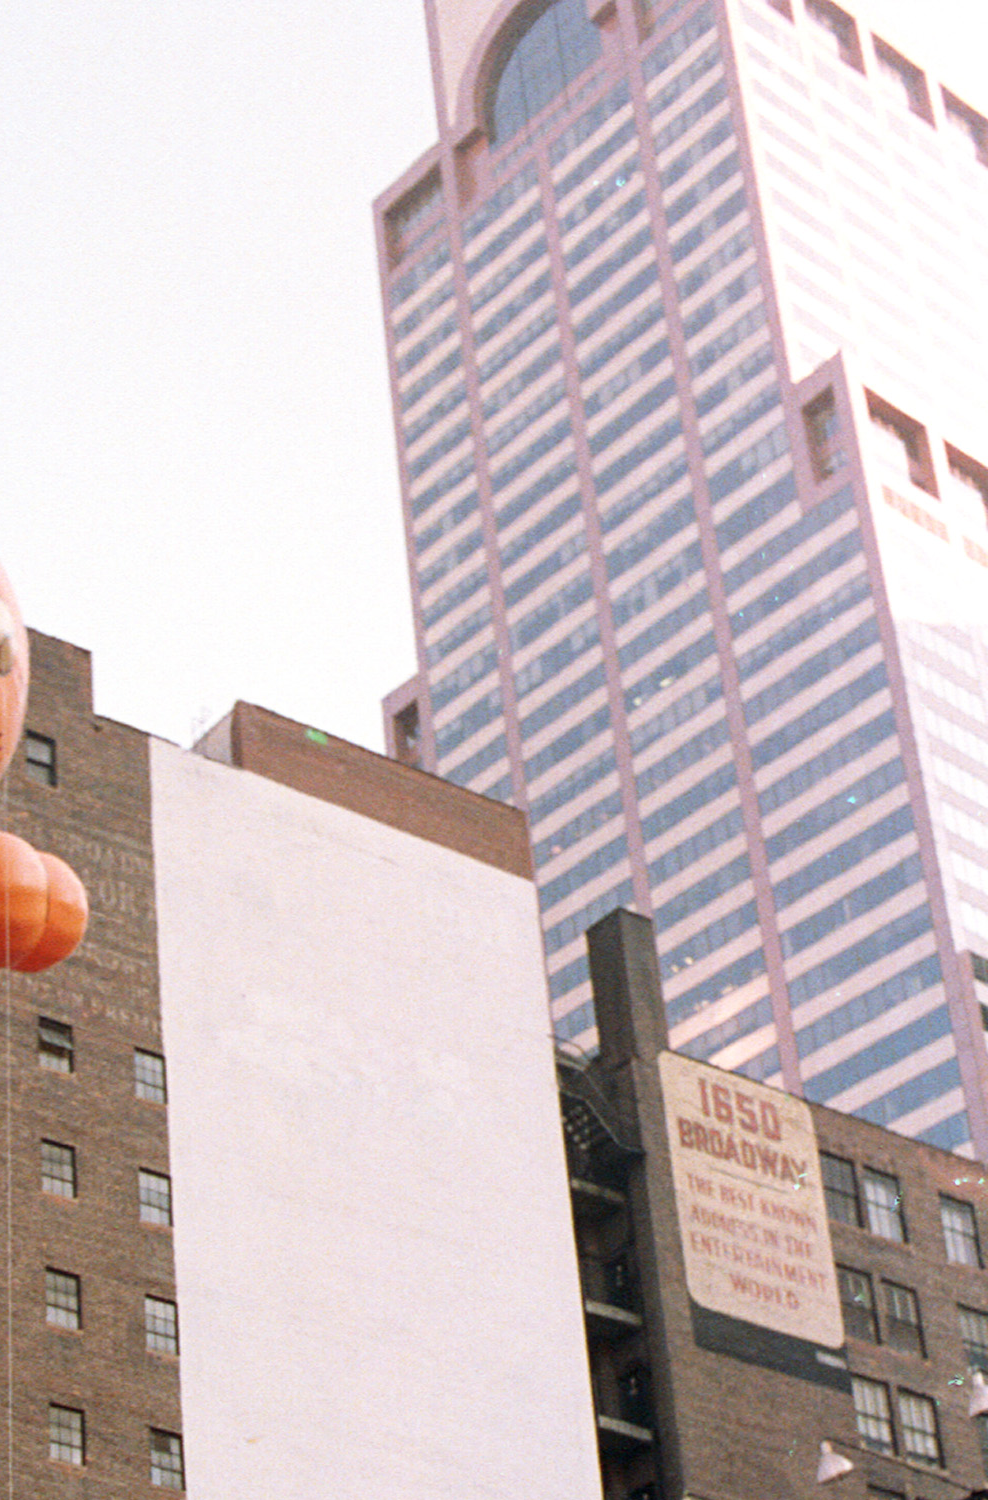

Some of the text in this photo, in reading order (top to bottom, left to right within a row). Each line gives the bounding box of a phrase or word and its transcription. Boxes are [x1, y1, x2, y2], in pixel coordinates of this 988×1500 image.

[697, 1077, 781, 1142] 1650
[677, 1116, 808, 1189] BROADWAY
[686, 1172, 713, 1196] THE
[719, 1184, 754, 1212] BEST
[784, 1234, 813, 1259] THE
[729, 1272, 800, 1310] WORLD
